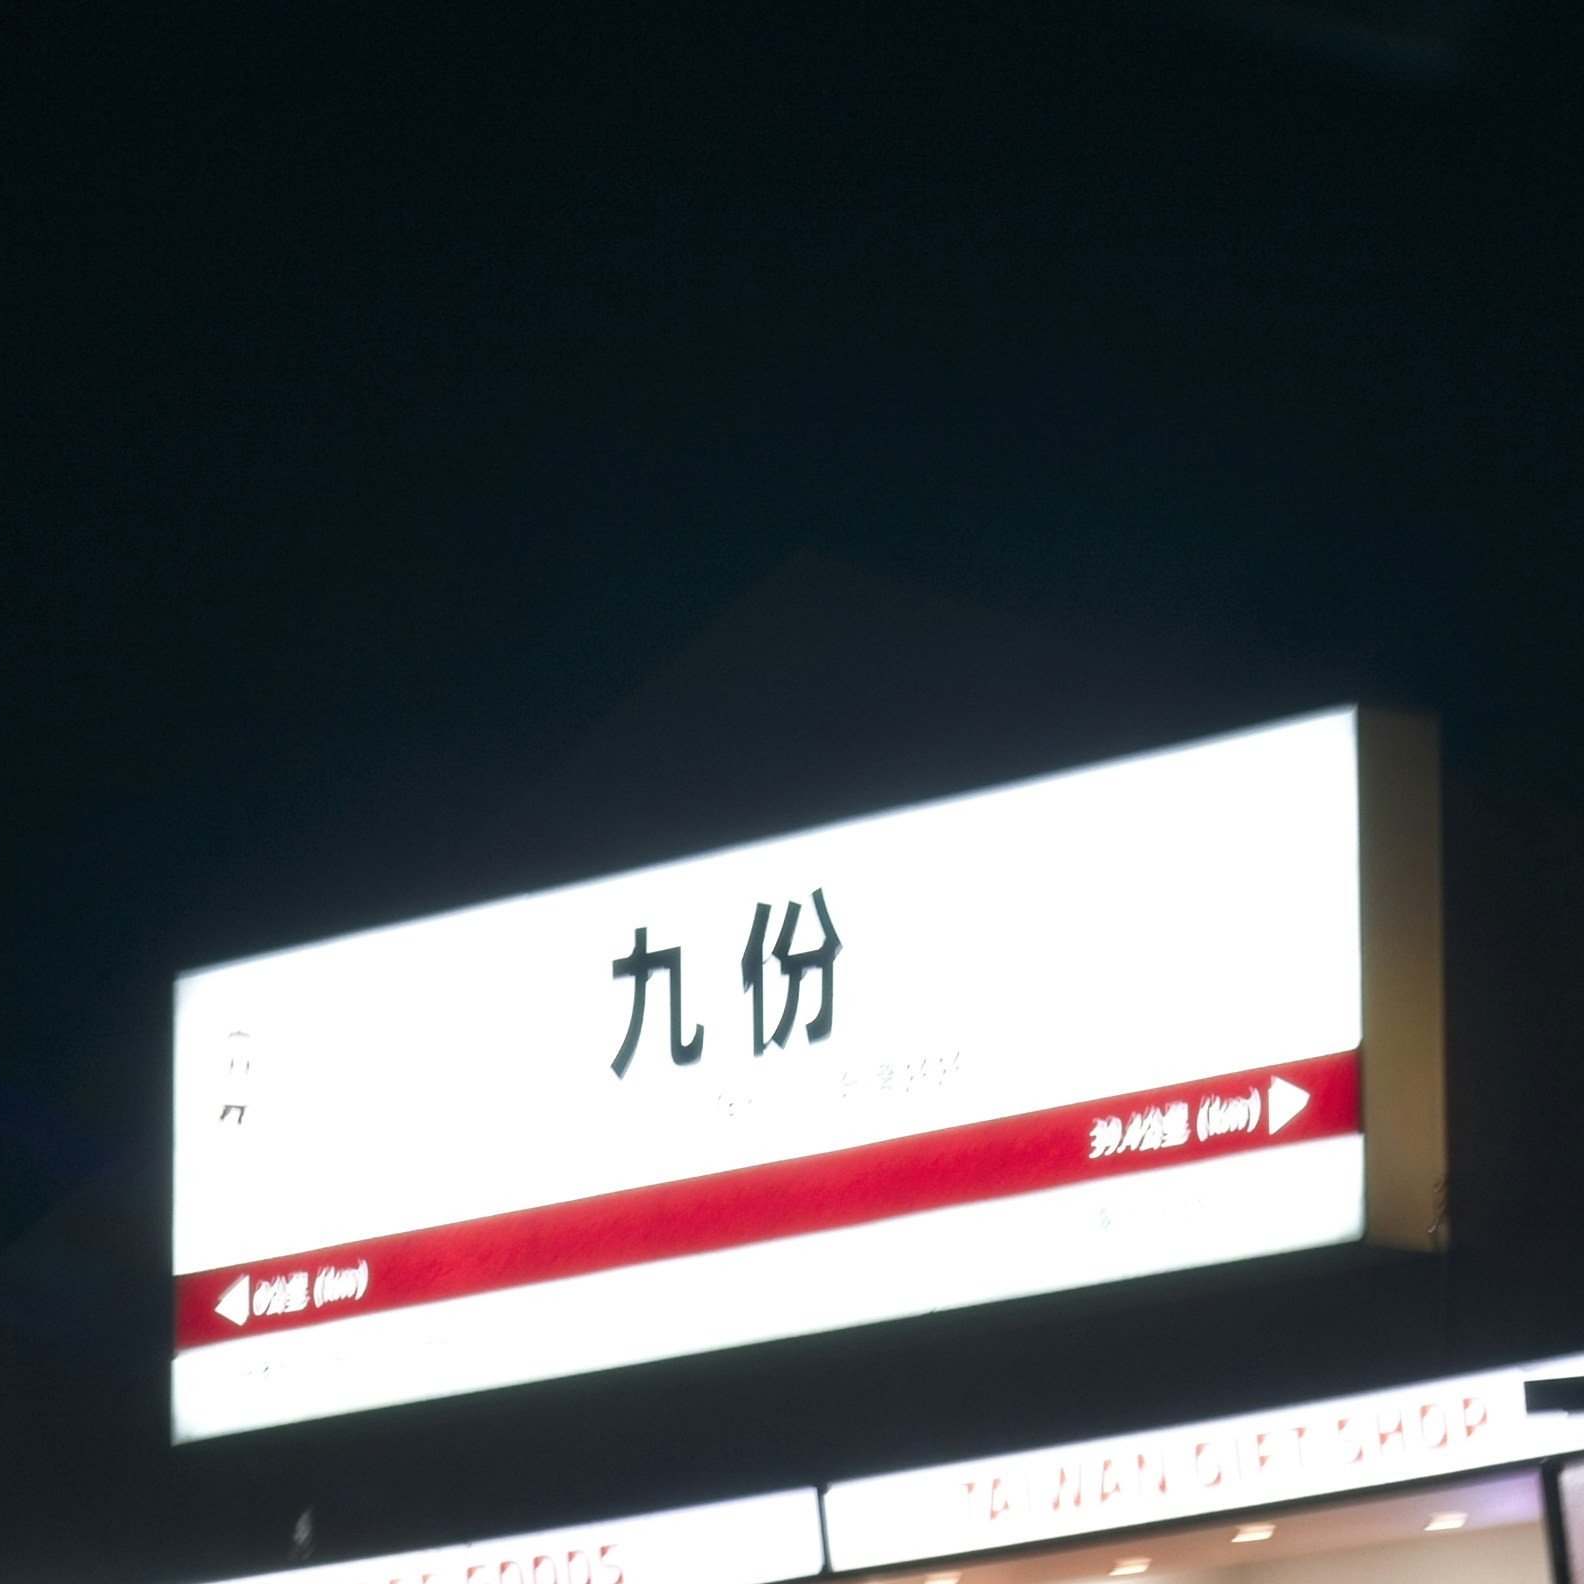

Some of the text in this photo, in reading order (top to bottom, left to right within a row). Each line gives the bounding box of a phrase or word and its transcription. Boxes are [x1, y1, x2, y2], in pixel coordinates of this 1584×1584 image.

[611, 887, 844, 1081] 九份
[959, 1396, 1489, 1522] TAIWAN GIFT SHOP
